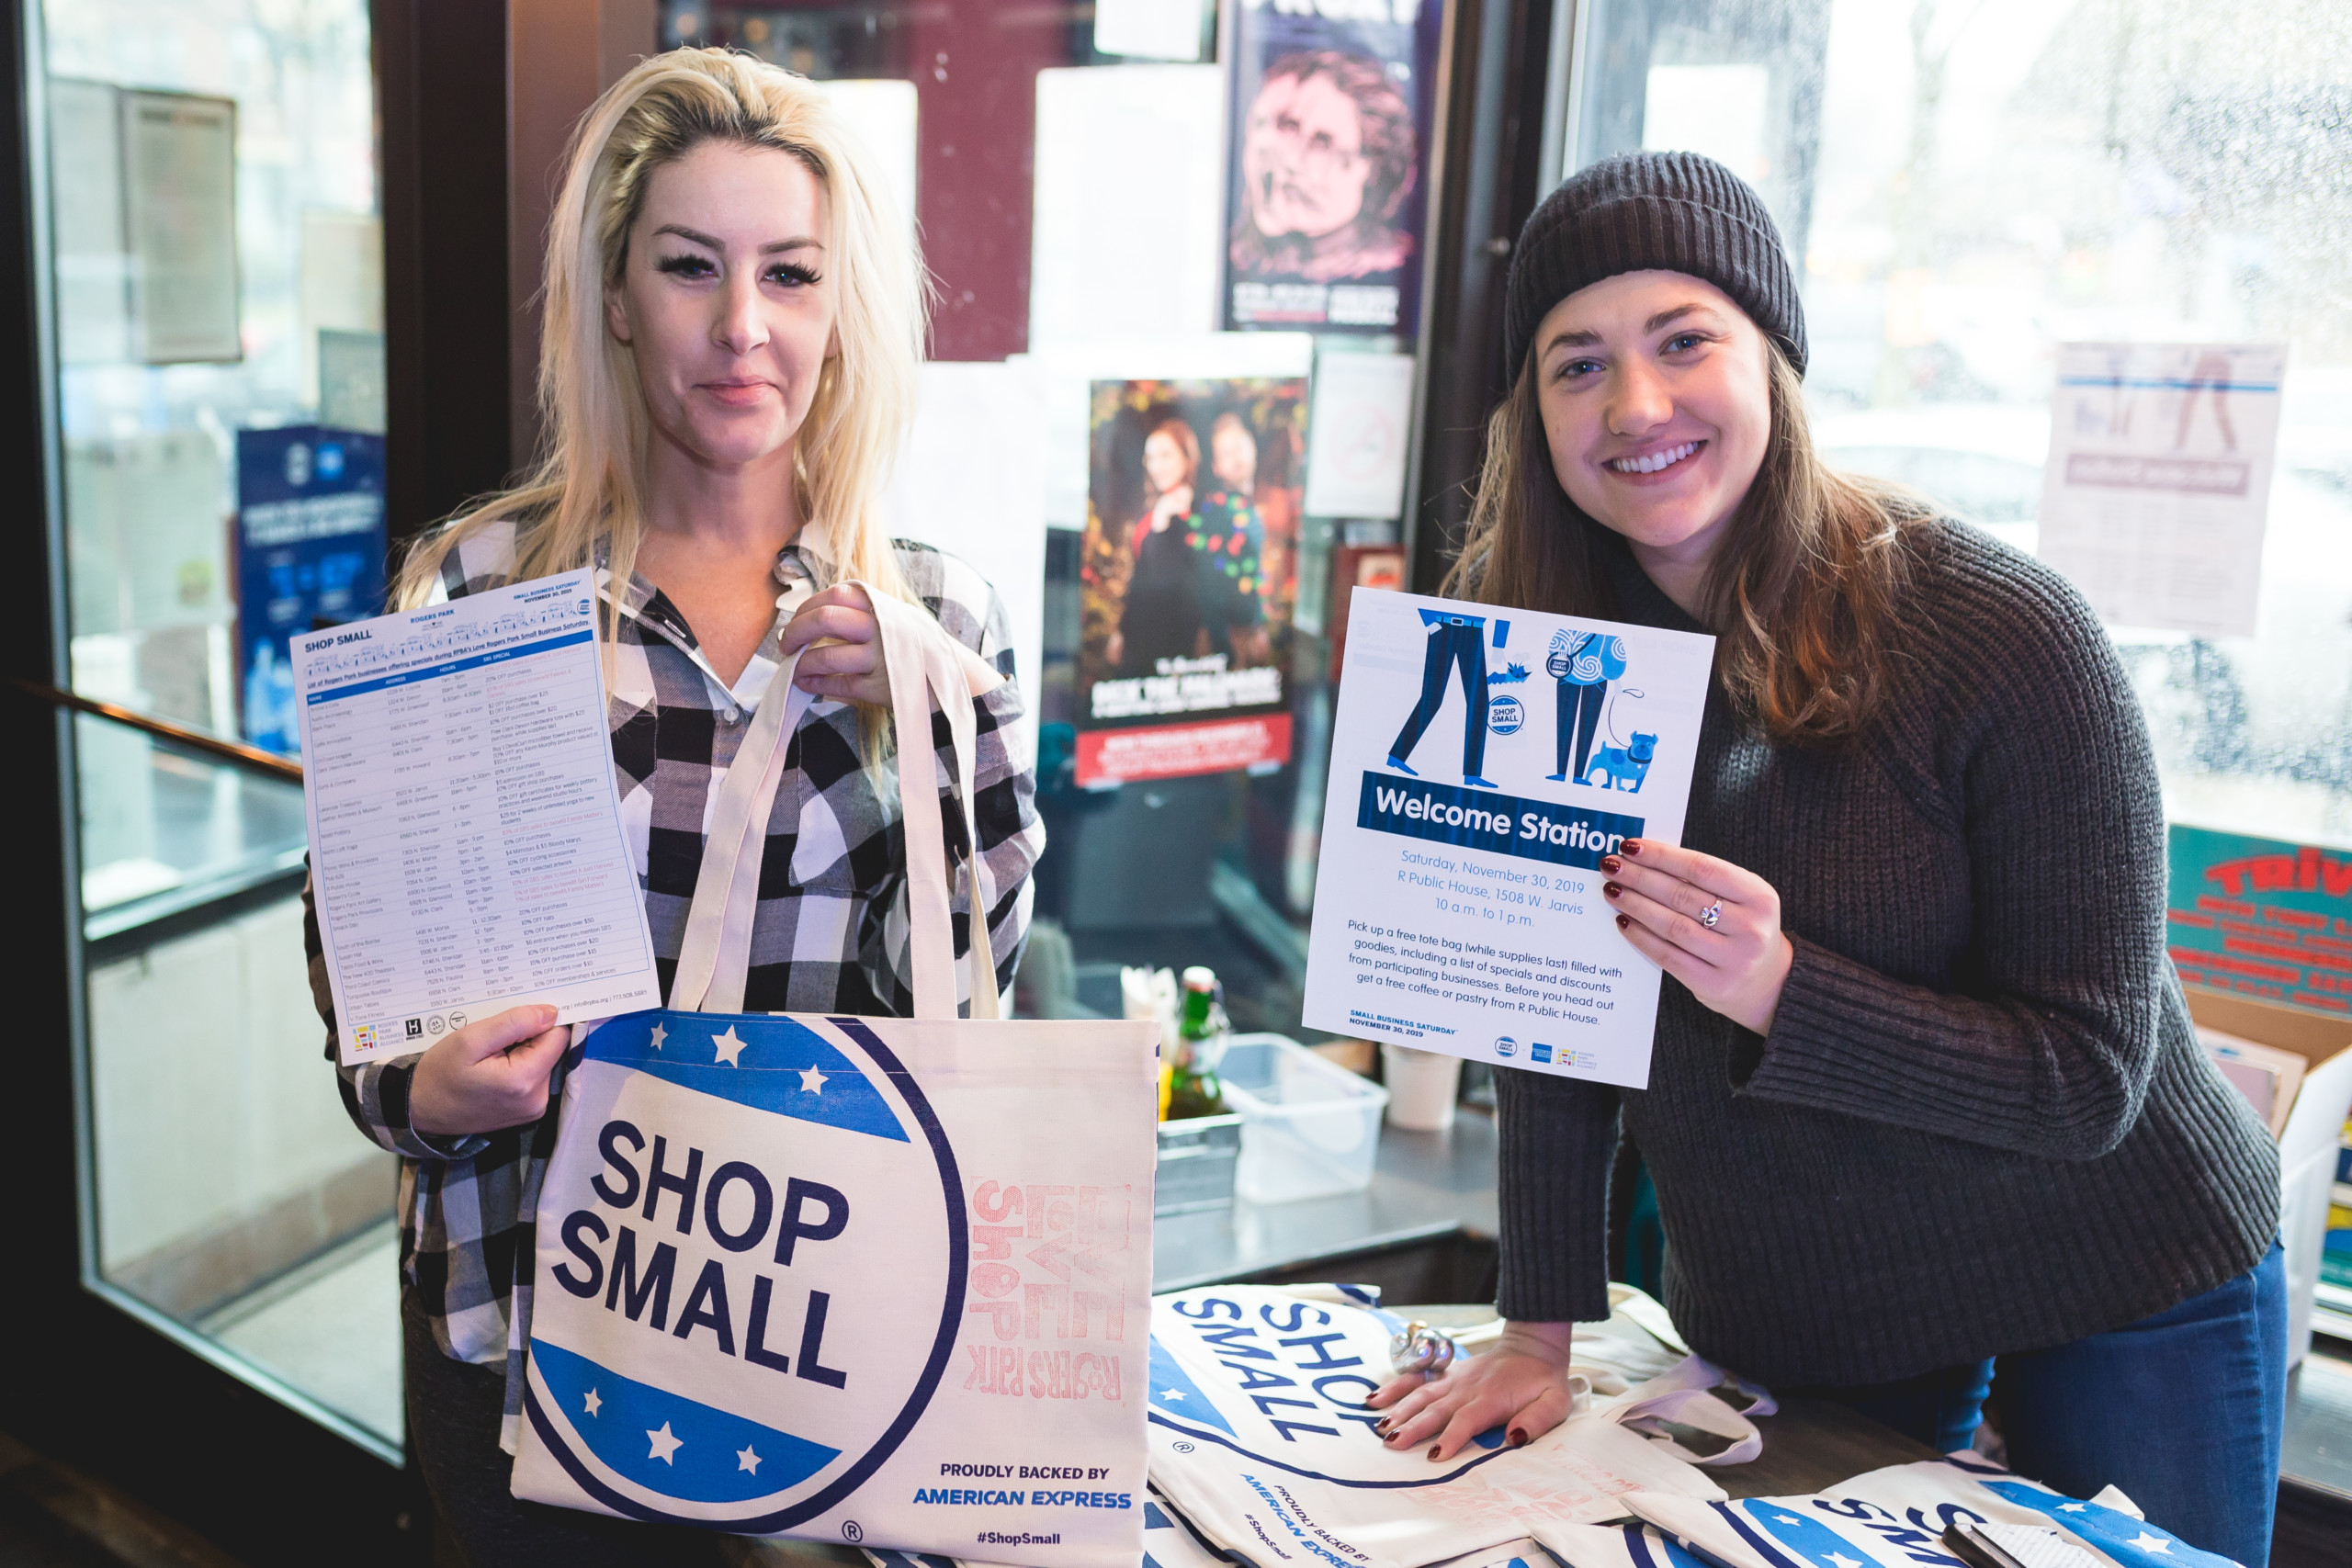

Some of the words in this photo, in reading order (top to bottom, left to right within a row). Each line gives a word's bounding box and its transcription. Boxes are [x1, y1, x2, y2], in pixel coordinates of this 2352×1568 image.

[524, 592, 550, 603] NOVEMBER
[530, 586, 554, 595] BUSINESS
[555, 580, 580, 590] SATURDAY
[410, 613, 436, 623] ROGERS
[305, 637, 334, 652] SHOP
[336, 629, 372, 645] SMALL
[324, 676, 343, 684] Rogers
[357, 667, 387, 677] businesses
[388, 661, 410, 671] offering
[411, 656, 433, 666] specials
[434, 651, 452, 660] during
[453, 647, 471, 655] RPBA's
[486, 638, 505, 647] Rogers
[520, 630, 537, 639] Small
[537, 626, 561, 636] Business
[1491, 715, 1518, 723] SMALL
[1493, 707, 1516, 716] SHOP
[1376, 785, 1511, 836] Welcome
[1520, 813, 1625, 856] Station
[1397, 869, 1406, 882] R
[1408, 872, 1444, 889] Public
[1448, 879, 1489, 899] House,
[1496, 888, 1523, 904] 1508
[1528, 894, 1544, 907] W.
[1547, 898, 1583, 915] Jarvis
[1401, 850, 1457, 873] Saturday,
[1462, 861, 1527, 884] November
[1531, 874, 1549, 889] 30,
[1555, 878, 1584, 893] 2019
[1436, 897, 1448, 910] 10
[1451, 903, 1477, 916] a.m.
[1483, 907, 1494, 919] to
[1499, 909, 1503, 920] 1
[1507, 913, 1534, 926] p.m.
[1348, 919, 1367, 932] Pick
[1370, 926, 1384, 937] up
[1386, 929, 1393, 937] a
[1396, 928, 1416, 941] free
[1419, 933, 1438, 945] tote
[1441, 937, 1462, 952] bag
[1464, 942, 1496, 956] (while
[1498, 950, 1542, 964] supplies
[1545, 956, 1567, 970] last)
[1571, 960, 1596, 974] filled
[1599, 967, 1622, 977] with
[1353, 940, 1396, 955] goodies,
[1400, 946, 1447, 966] including
[1459, 957, 1474, 968] list
[1476, 961, 1487, 971] of
[1489, 965, 1532, 979] specials
[1535, 974, 1556, 984] and
[1559, 976, 1611, 993] discounts
[1349, 953, 1372, 966] from
[1374, 960, 1438, 981] participating
[1441, 970, 1501, 991] businesses.
[1505, 983, 1539, 998] Before
[1542, 991, 1562, 1001] you
[1565, 992, 1593, 1007] head
[1596, 1000, 1613, 1010] out
[1356, 974, 1373, 983] get
[1385, 976, 1405, 989] free
[1408, 983, 1439, 996] coffee
[1455, 992, 1487, 1007] pastry
[1490, 996, 1515, 1010] from
[1518, 1002, 1525, 1011] R
[1528, 1003, 1559, 1018] Public
[1562, 1010, 1600, 1024] House.
[1349, 1018, 1391, 1031] NOVEMBER
[1393, 1026, 1403, 1034] 30,
[1405, 1029, 1423, 1037] 2019
[1351, 1010, 1374, 1020] SMALL
[1376, 1014, 1414, 1027] BUSINESS
[591, 1120, 850, 1267] SHOP
[550, 1210, 847, 1390] SMALL
[1171, 1298, 1341, 1442] SMALL
[941, 1463, 1013, 1478] PROUDLY
[1019, 1466, 1083, 1479] BACKED
[1088, 1468, 1109, 1480] BY
[913, 1488, 1025, 1506] AMERICAN
[1031, 1490, 1132, 1509] EXPRESS
[1239, 1473, 1306, 1538] AMERICAN
[1300, 1540, 1367, 1568] EXPRE
[977, 1531, 1060, 1547] #ShopSmall
[1244, 1513, 1293, 1560] #ShopSmall
[1274, 1485, 1318, 1528] PROUDLY
[1314, 1529, 1357, 1553] BACKED
[1353, 1553, 1373, 1562] BY
